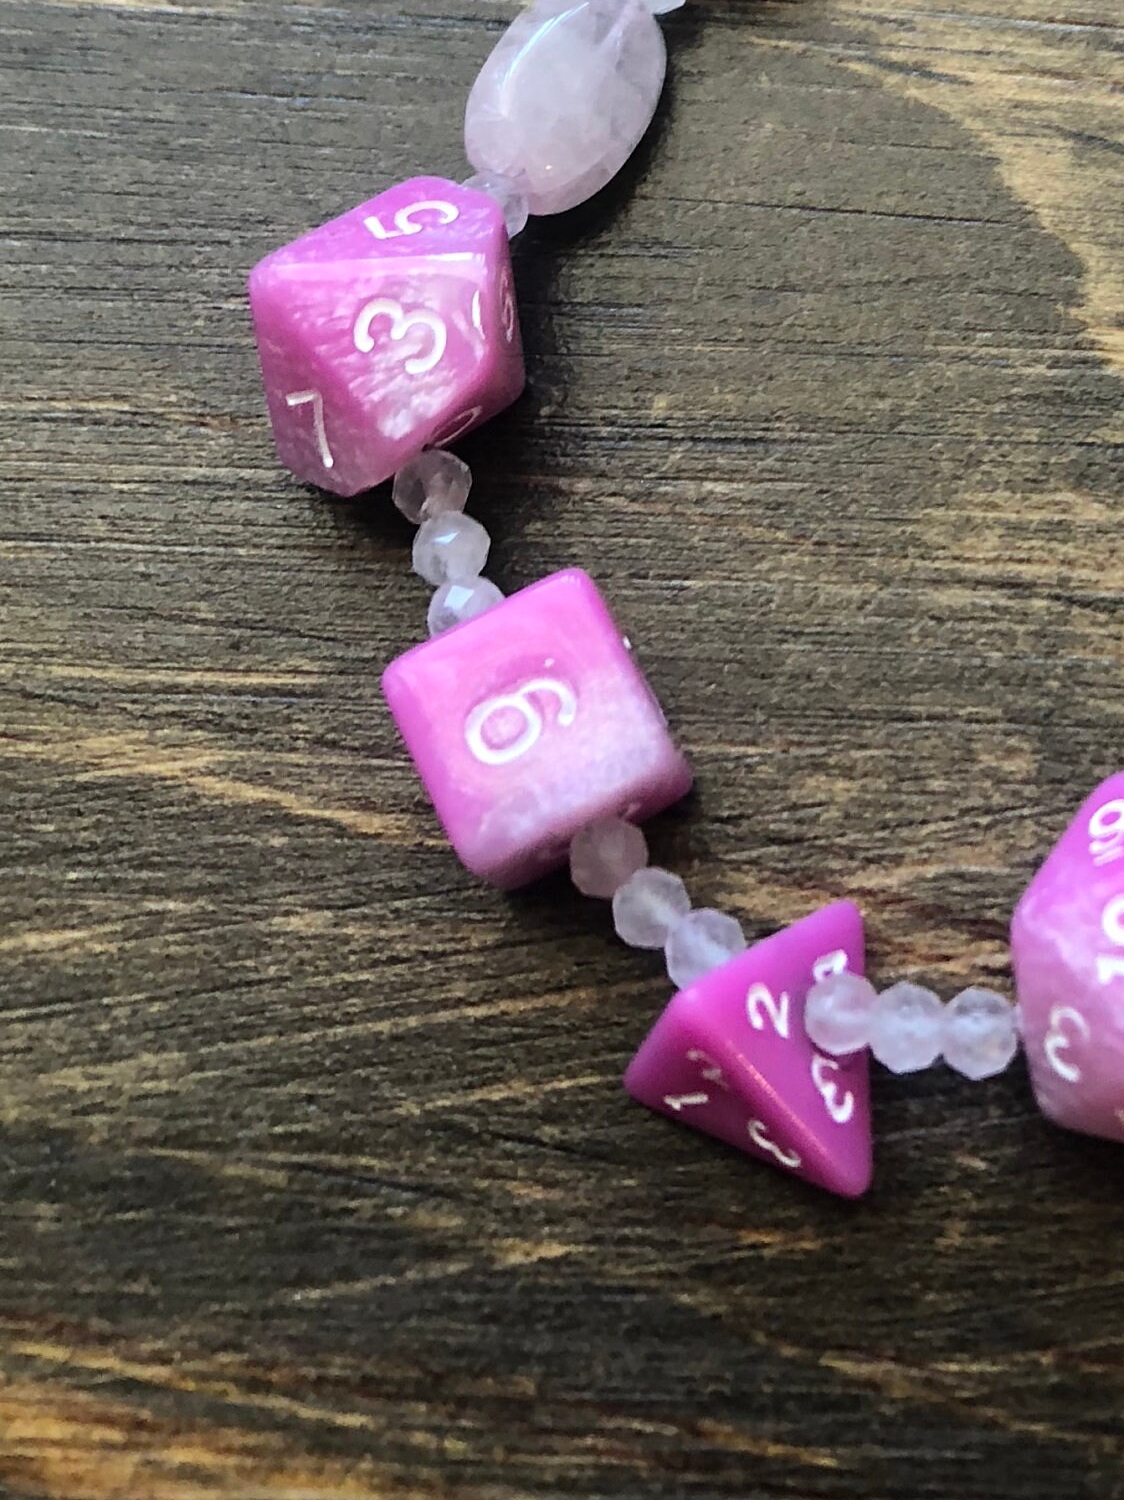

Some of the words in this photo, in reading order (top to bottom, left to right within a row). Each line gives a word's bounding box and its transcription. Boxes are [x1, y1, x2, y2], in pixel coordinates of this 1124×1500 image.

[363, 199, 459, 240] 5
[353, 297, 447, 375] 3
[285, 389, 334, 469] 7
[746, 981, 790, 1040] 2
[1043, 1005, 1091, 1083] 3
[811, 1053, 854, 1124] 3
